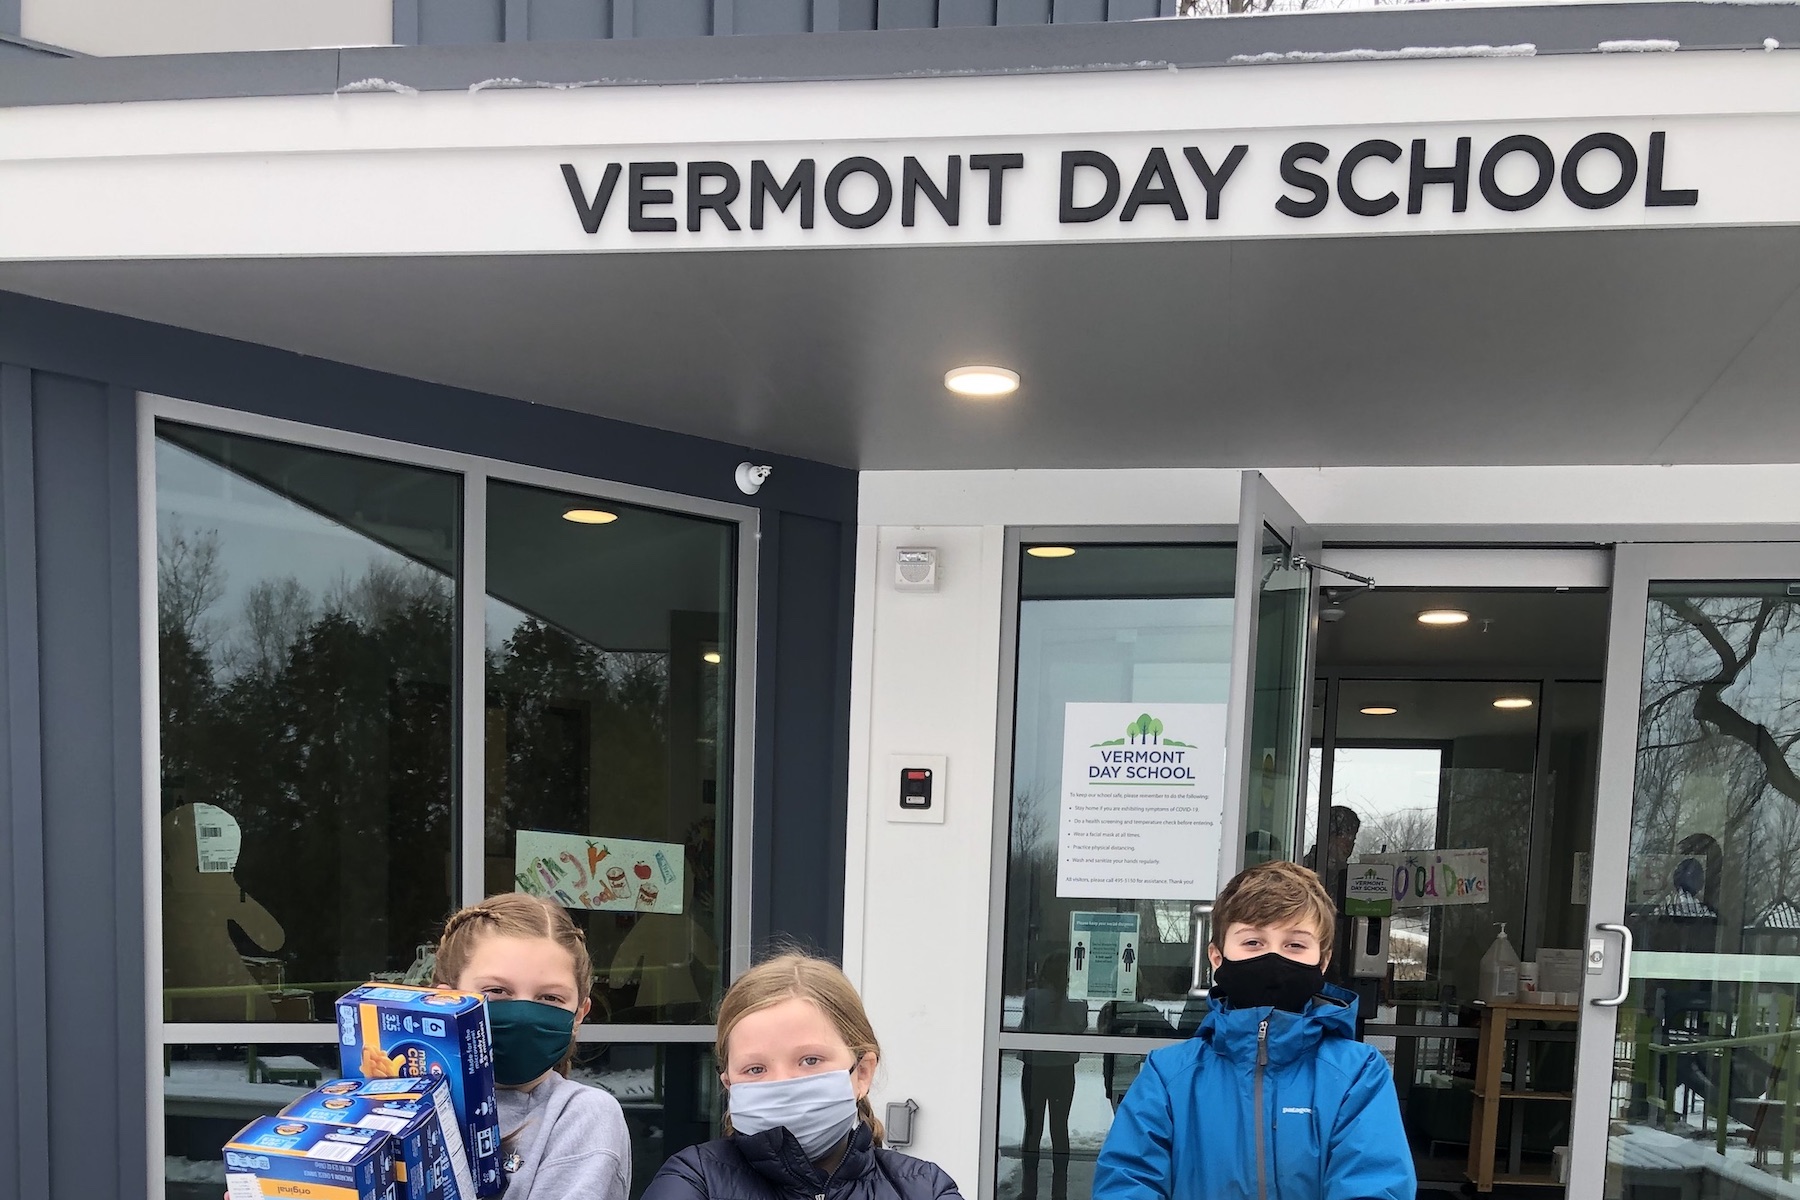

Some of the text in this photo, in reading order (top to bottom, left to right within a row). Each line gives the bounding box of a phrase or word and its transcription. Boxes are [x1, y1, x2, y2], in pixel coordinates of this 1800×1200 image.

[560, 132, 1698, 233] VERMONT DAY SCHOOL
[1101, 751, 1185, 764] VERMONT
[1089, 766, 1196, 780] DAY SCHOOL
[386, 1014, 397, 1031] 3.5
[430, 1023, 442, 1032] 6
[277, 1186, 311, 1196] original
